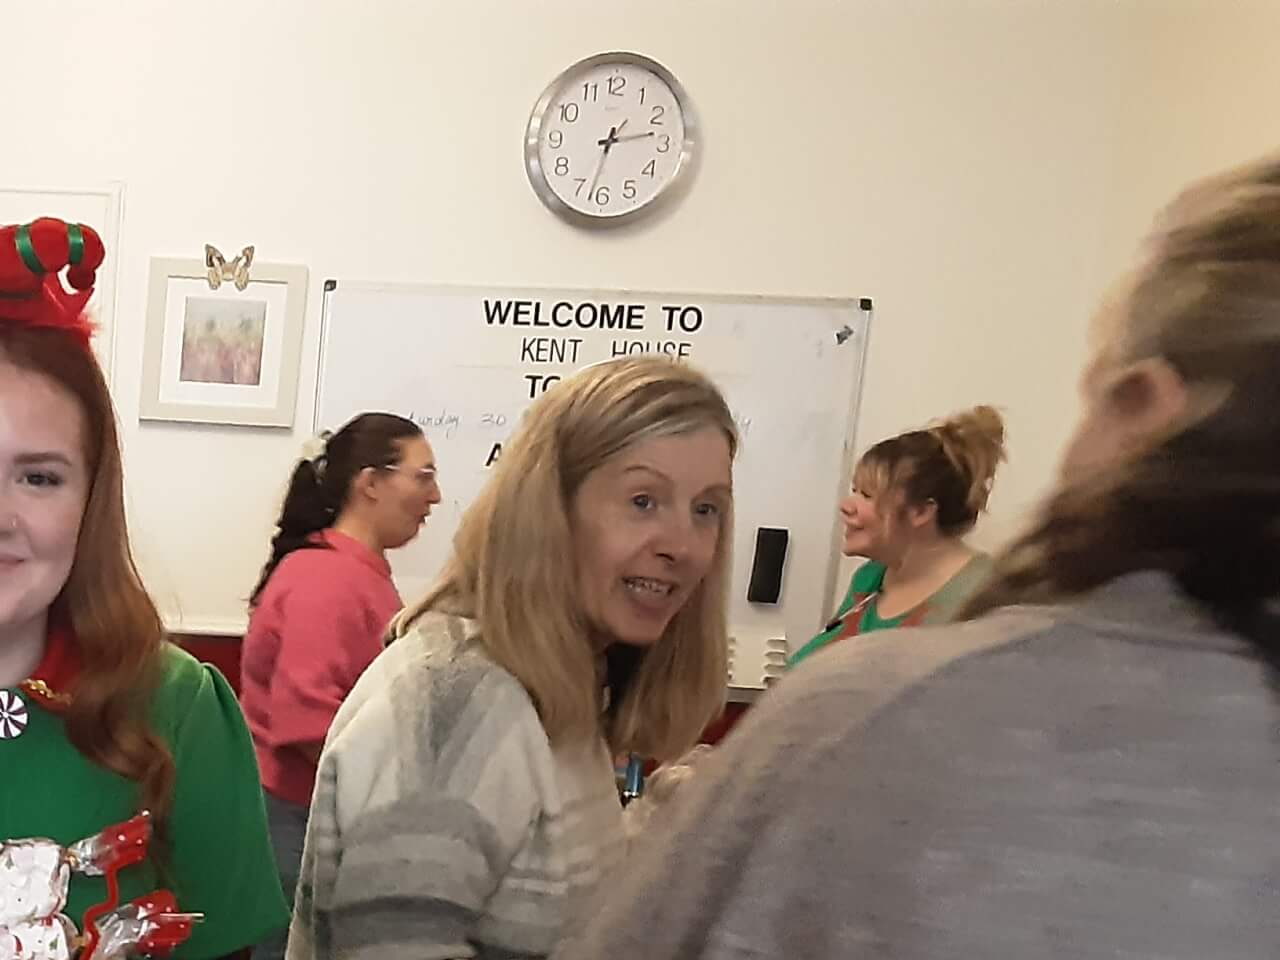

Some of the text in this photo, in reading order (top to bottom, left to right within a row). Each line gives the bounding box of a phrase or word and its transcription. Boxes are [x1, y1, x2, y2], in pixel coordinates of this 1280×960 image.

[583, 83, 598, 102] 11
[606, 76, 626, 96] 12
[639, 87, 646, 105] 1
[560, 102, 579, 122] 10
[650, 105, 665, 125] 2
[548, 130, 563, 149] 9
[656, 134, 670, 153] 3
[554, 156, 569, 176] 8
[641, 159, 656, 179] 4
[573, 178, 587, 197] 7
[595, 186, 610, 205] 6
[622, 180, 636, 199] 5
[483, 299, 703, 332] WELCOME TO
[521, 337, 583, 363] KENT
